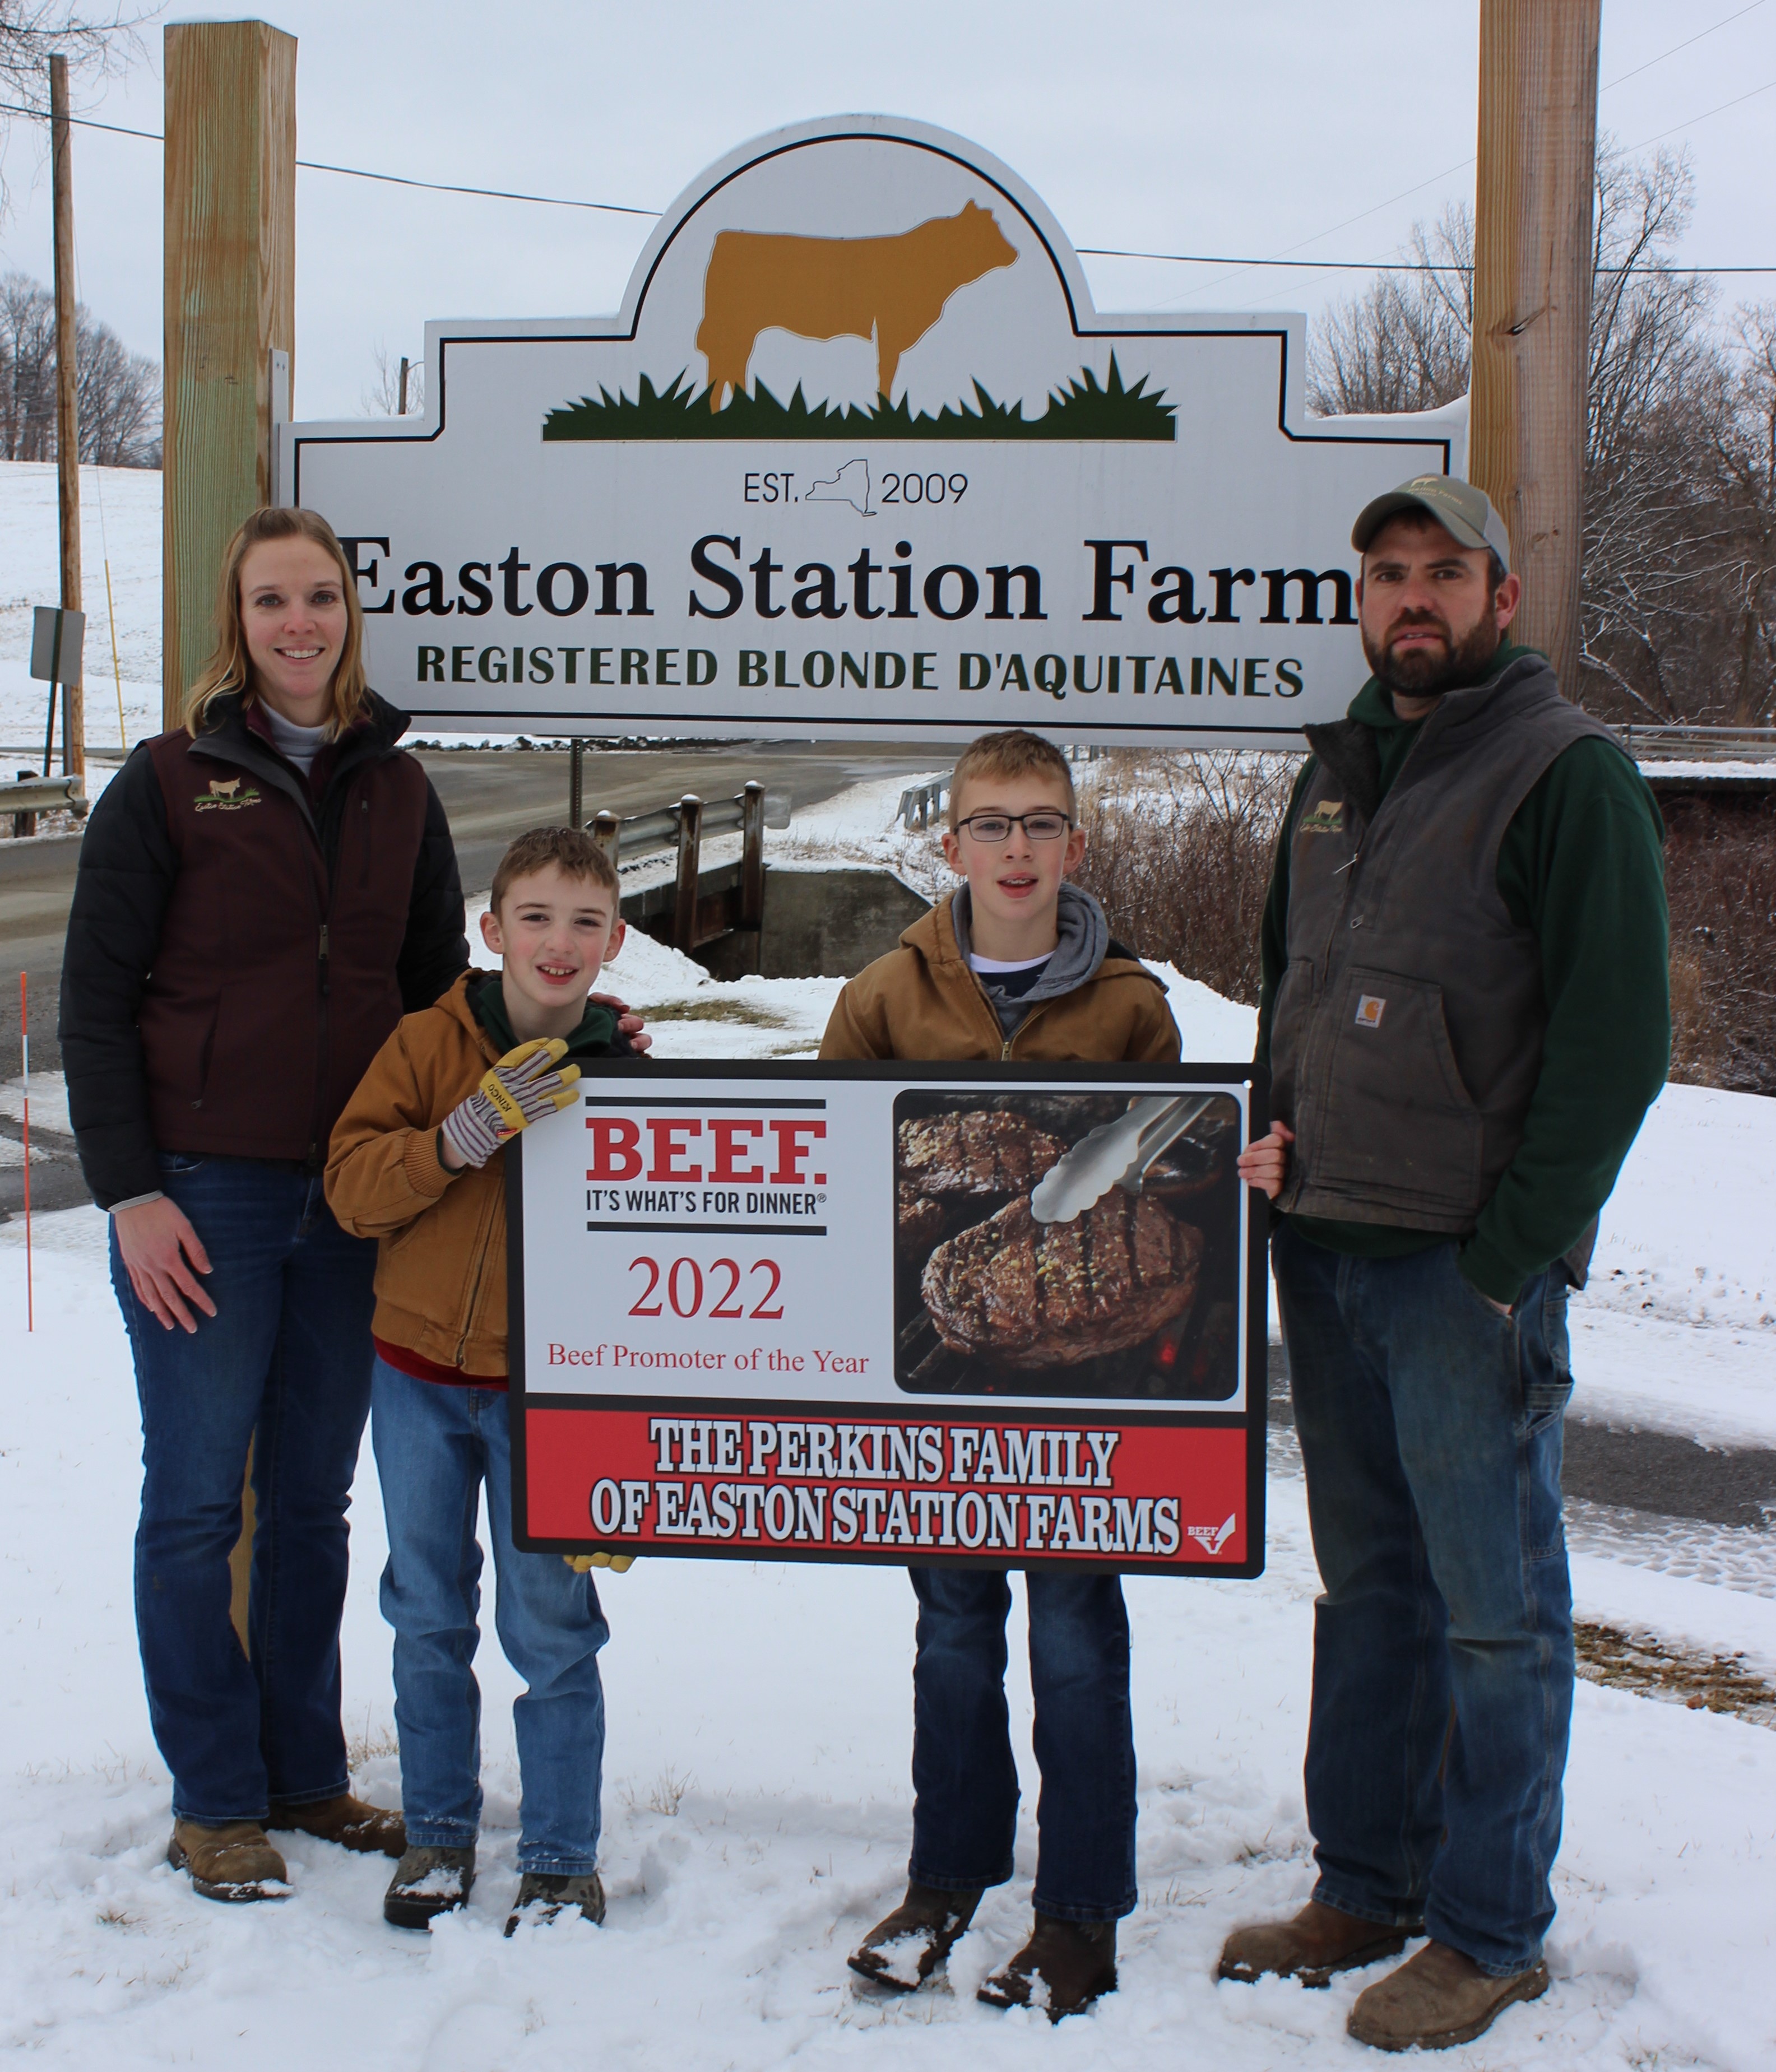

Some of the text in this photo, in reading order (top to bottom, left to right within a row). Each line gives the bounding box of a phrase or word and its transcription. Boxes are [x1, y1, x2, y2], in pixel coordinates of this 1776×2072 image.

[744, 473, 968, 504] EST. 2009
[337, 537, 655, 616] Easton
[689, 535, 1048, 621] Station
[417, 645, 1304, 700] REGISTERED BLONDE D'AQUITAINES
[489, 1084, 512, 1112] KINCO
[586, 1190, 620, 1211] IT'S
[625, 1191, 697, 1212] WHAT'S
[703, 1192, 740, 1213] FOR
[628, 1256, 785, 1320] 2022
[548, 1343, 869, 1373] Beef Promoter of the Year
[650, 1419, 1119, 1487] THE PERKINS FAMILY
[591, 1478, 1180, 1555] OF EASTON STATION FARMS
[1187, 1526, 1219, 1536] BEEF
